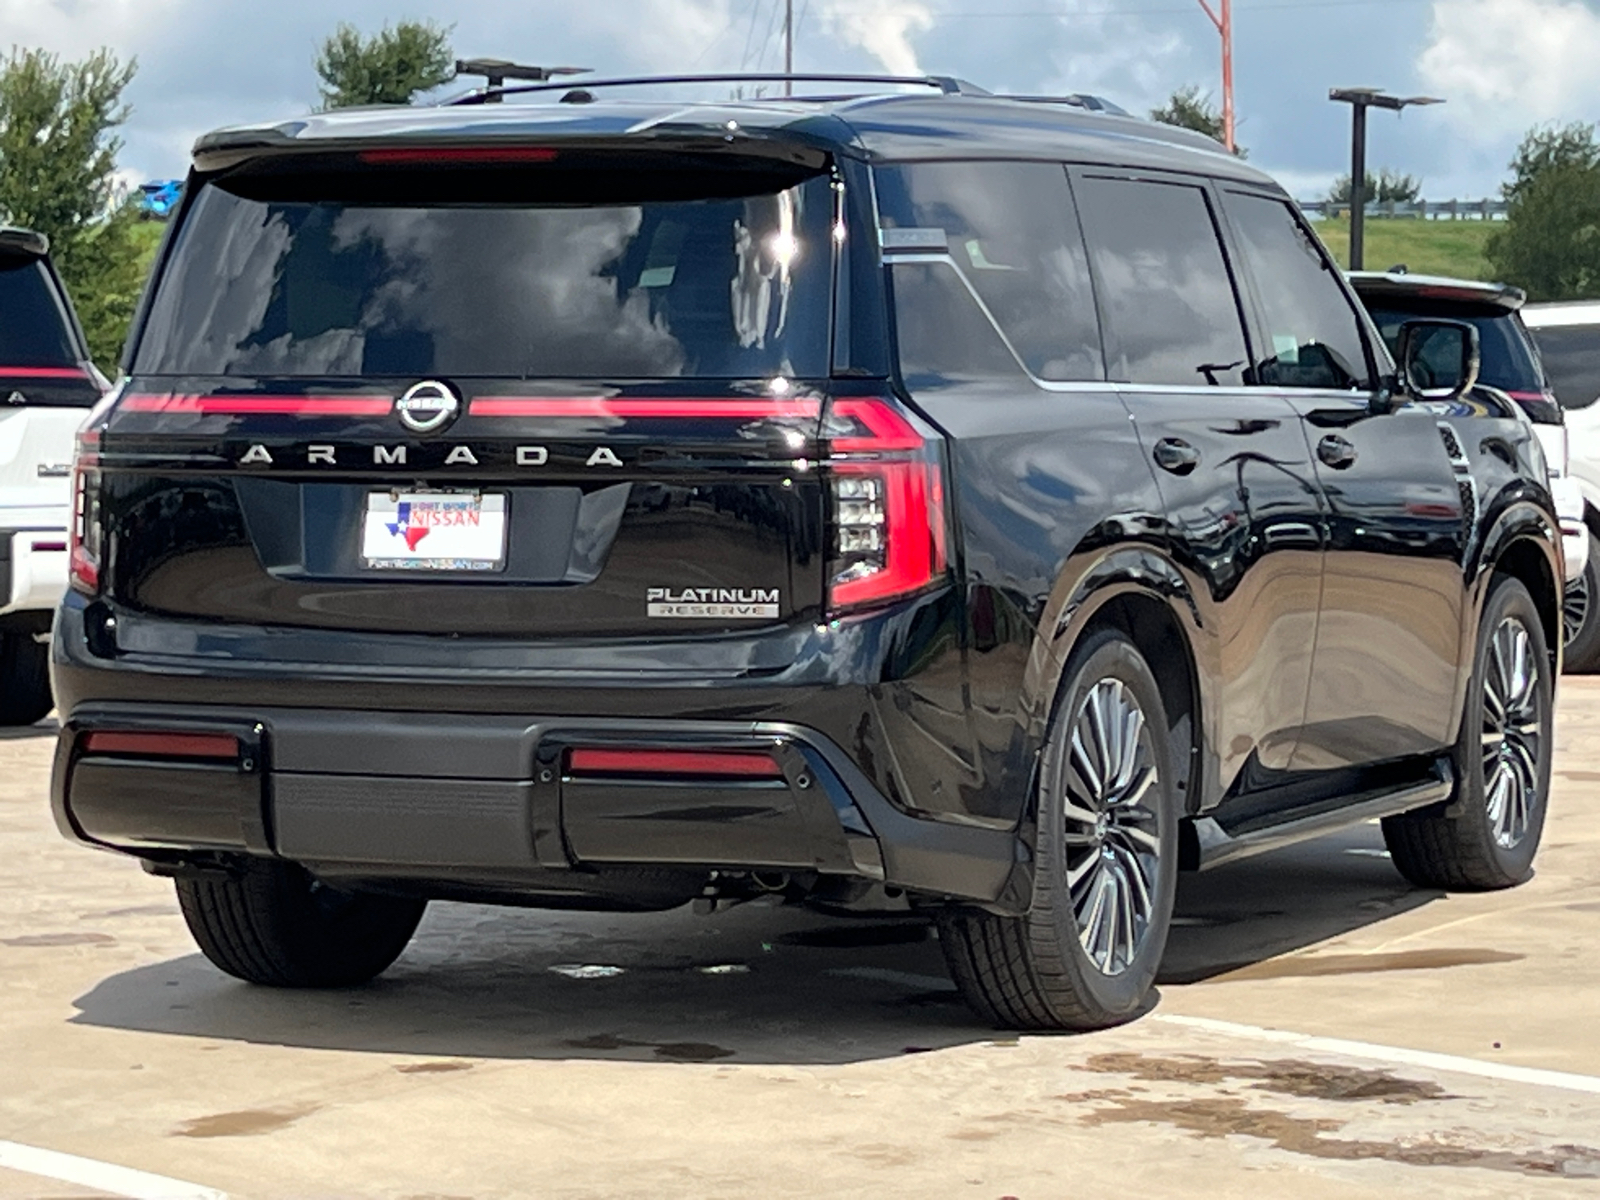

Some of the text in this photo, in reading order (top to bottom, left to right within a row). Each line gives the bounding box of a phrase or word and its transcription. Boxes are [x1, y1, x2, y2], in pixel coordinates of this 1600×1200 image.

[240, 444, 623, 467] ARMADA
[412, 510, 480, 526] NISSAN
[647, 588, 780, 602] PLATINUM
[660, 605, 766, 616] RESERVE
